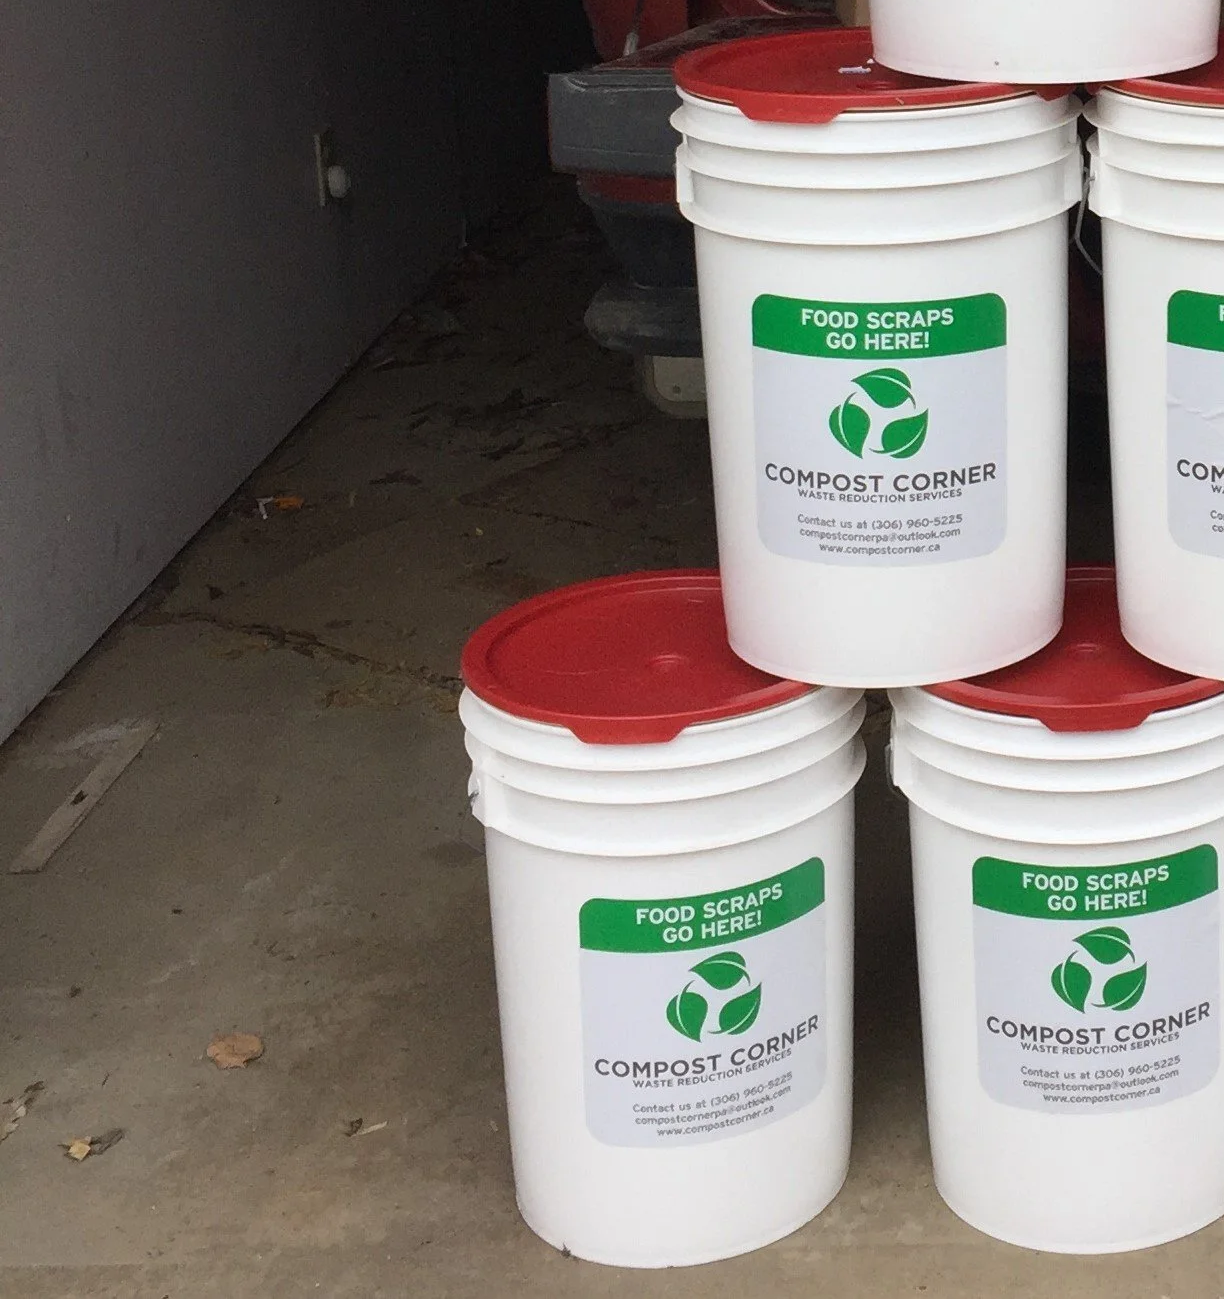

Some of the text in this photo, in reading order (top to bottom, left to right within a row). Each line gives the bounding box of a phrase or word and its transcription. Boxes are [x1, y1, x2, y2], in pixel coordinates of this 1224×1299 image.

[802, 308, 954, 329] FOOD SCRAPS
[826, 332, 929, 350] GO HERE!
[765, 463, 996, 493] COMPOST CORNER
[798, 489, 962, 503] WASTE REDUCTION SERVICES
[797, 515, 836, 528] Contact
[856, 520, 867, 529] at
[872, 519, 902, 530] (306)
[907, 514, 963, 528] 960-5225
[819, 543, 940, 555] www.compostcorner.ca
[1023, 865, 1169, 891] FOOD SCRAPS
[636, 883, 782, 924] FOOD SCRAPS
[1048, 890, 1147, 911] GO HERE!
[663, 911, 762, 944] GO HERE!
[987, 1002, 1210, 1045] COMPOST CORNER
[595, 1015, 818, 1079] COMPOST CORNER
[1021, 1031, 1179, 1055] WASTE REDUCTION SERVICES
[633, 1048, 792, 1088] WASTE REDUCTION SERVICES
[1021, 1066, 1059, 1079] Contact
[1080, 1070, 1090, 1079] at
[1095, 1068, 1125, 1080] (306)
[633, 1093, 740, 1114] Contact us at (306)
